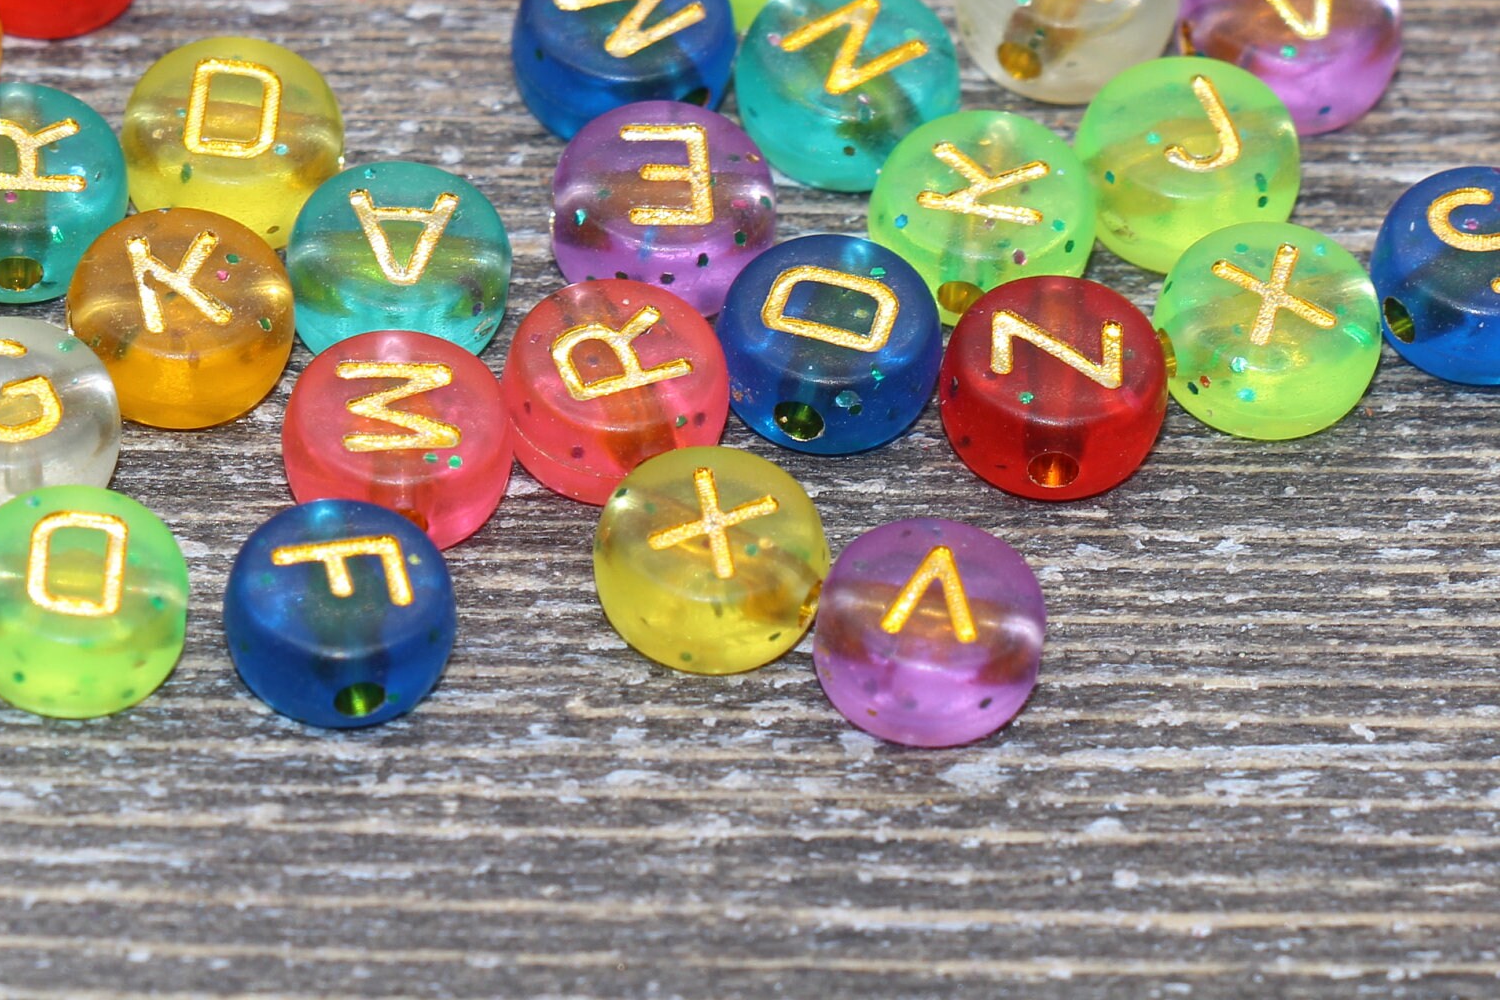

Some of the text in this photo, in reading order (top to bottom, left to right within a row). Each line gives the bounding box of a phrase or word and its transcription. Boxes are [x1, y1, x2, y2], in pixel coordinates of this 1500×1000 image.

[183, 56, 283, 160] D
[1163, 74, 1242, 172] J
[618, 123, 715, 226] E
[916, 140, 1051, 226] K
[125, 230, 235, 337] K
[348, 187, 461, 286] A
[760, 264, 901, 353] D
[1210, 243, 1338, 346] X
[550, 304, 694, 402] R
[26, 509, 130, 618] D
[271, 533, 414, 607] F
[647, 466, 781, 580] X
[880, 544, 978, 645] V
